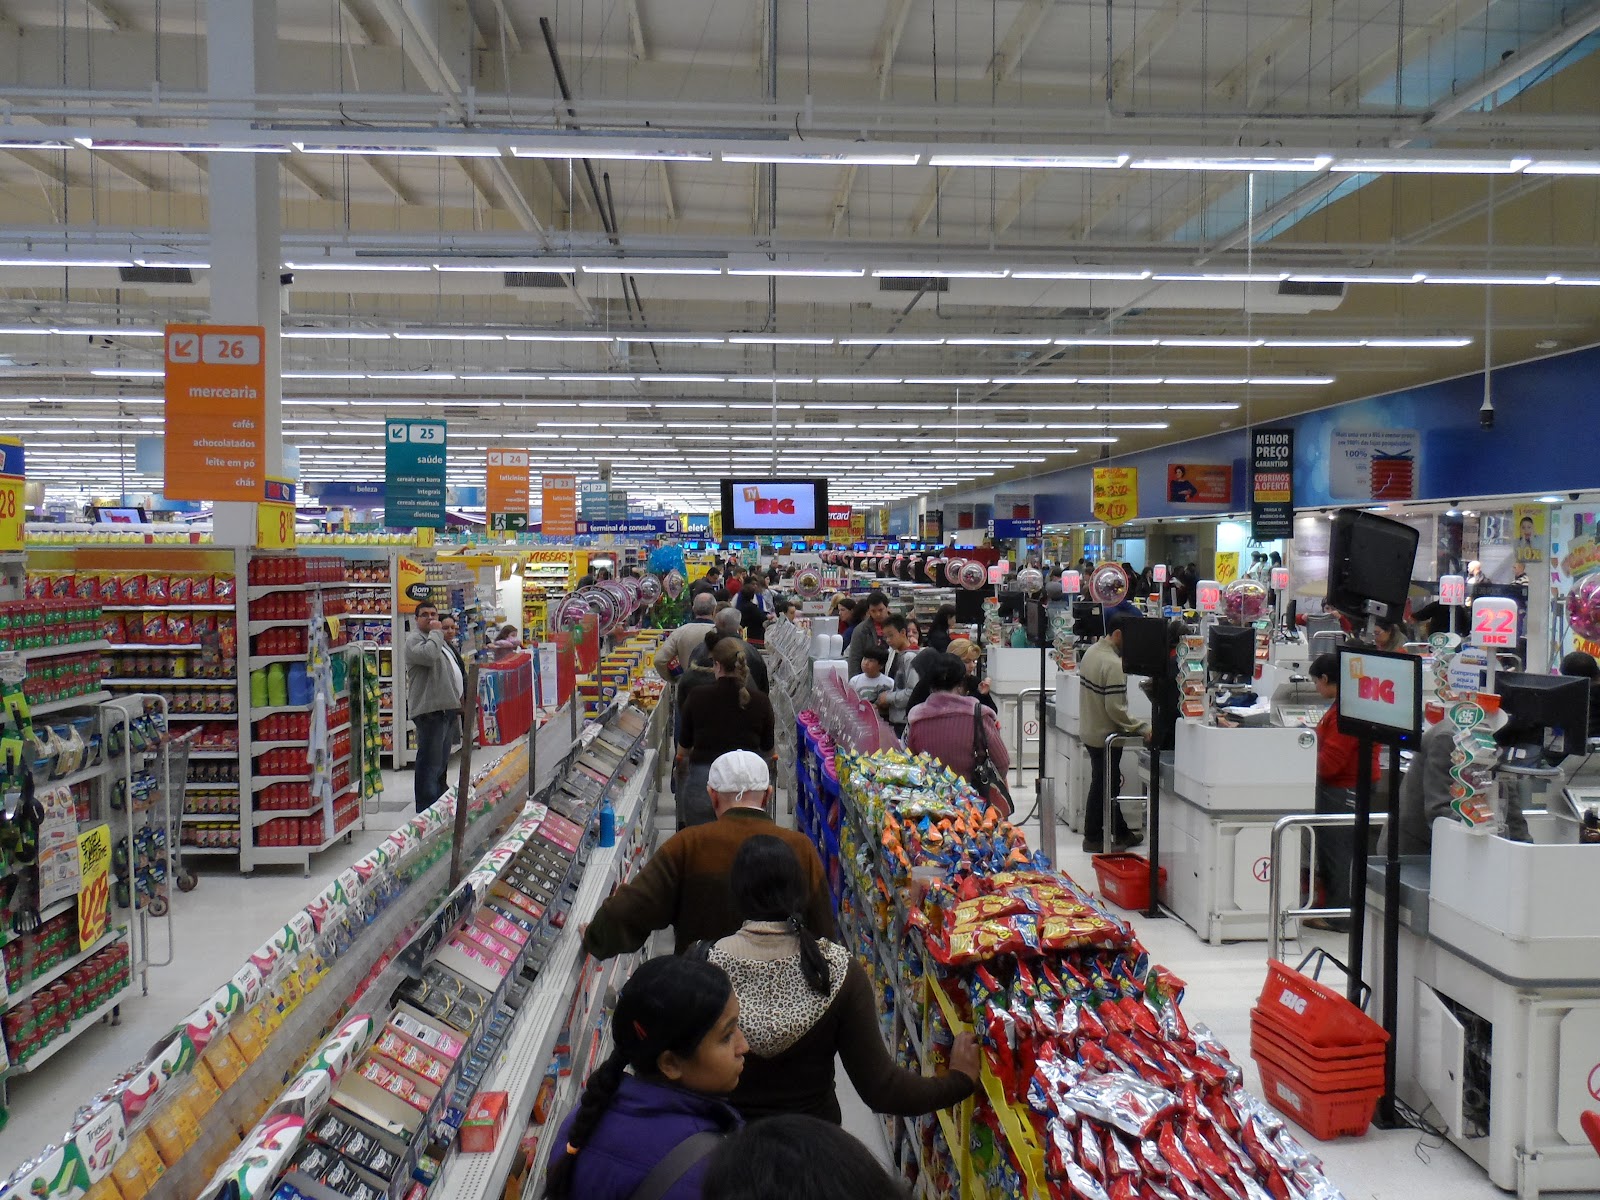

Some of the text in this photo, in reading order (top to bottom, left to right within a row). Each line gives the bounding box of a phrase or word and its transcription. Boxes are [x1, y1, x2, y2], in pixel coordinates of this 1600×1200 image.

[218, 340, 244, 358] 26
[189, 385, 257, 399] mercearia
[232, 420, 255, 429] cafés
[420, 428, 435, 439] 25
[193, 438, 256, 448] achocolatados
[1255, 434, 1289, 445] MENOR
[1256, 446, 1289, 460] PREÇO
[1344, 450, 1368, 458] 100%
[206, 457, 225, 467] leite
[243, 459, 255, 469] pó
[417, 455, 443, 464] saúde
[509, 455, 521, 463] 24
[1255, 460, 1288, 468] GARANTIDO
[1254, 473, 1290, 482] COBRIMOS
[235, 478, 255, 487] chás
[1255, 482, 1289, 490] A OFERTA
[356, 485, 378, 493] beleza
[417, 488, 440, 496] integrais
[755, 498, 795, 514] BIG
[590, 524, 618, 532] terminal
[411, 585, 430, 593] Bom
[1201, 588, 1220, 603] 20
[1474, 607, 1515, 633] 22
[1482, 635, 1509, 643] BIG
[1358, 675, 1395, 704] BIG
[1462, 709, 1475, 717] tic
[1458, 715, 1473, 724] tac
[1278, 988, 1308, 1015] BIG
[86, 1115, 112, 1144] Trident
